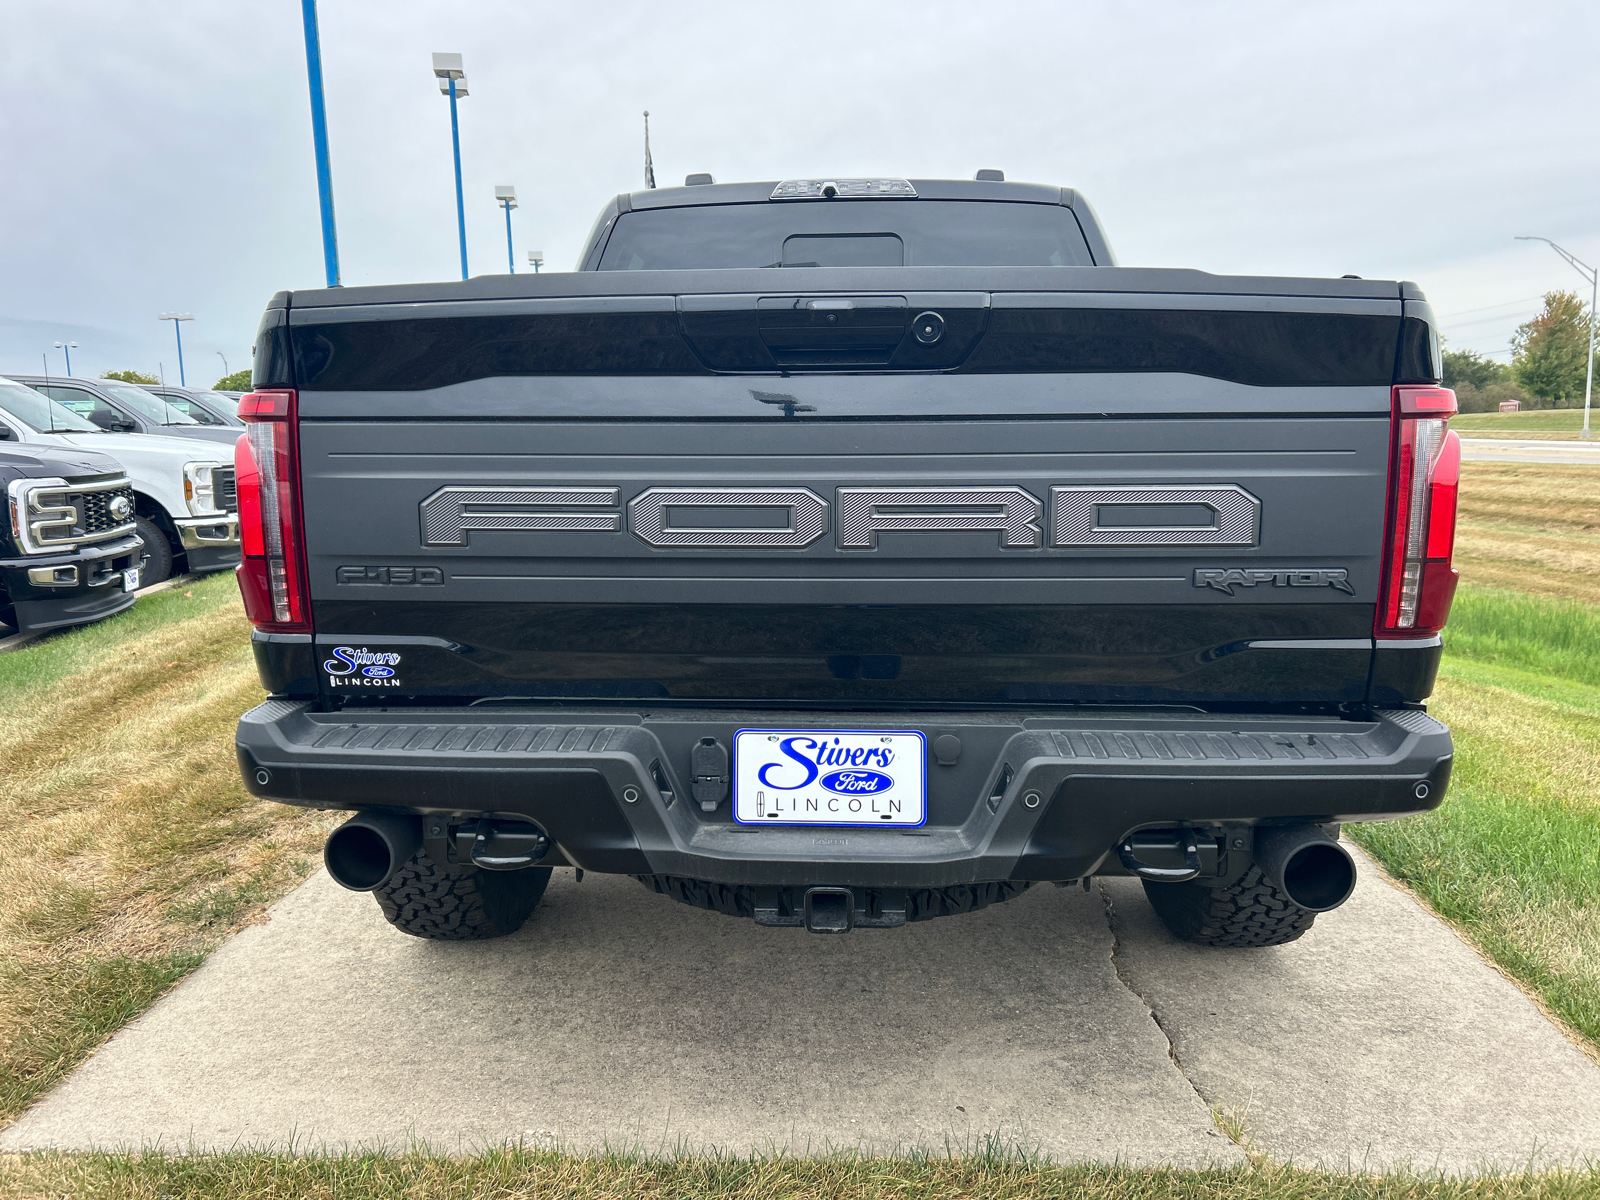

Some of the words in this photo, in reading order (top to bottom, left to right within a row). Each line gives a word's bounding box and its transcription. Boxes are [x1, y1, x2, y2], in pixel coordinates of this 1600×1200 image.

[420, 484, 1262, 549] FORD
[336, 565, 444, 586] F-150
[1193, 568, 1355, 597] RAPTOR
[324, 647, 401, 675] Stivers
[336, 678, 400, 687] LINCOLN
[758, 737, 895, 790] Stivers
[835, 772, 878, 791] Ford
[776, 798, 902, 813] LINCOLN
